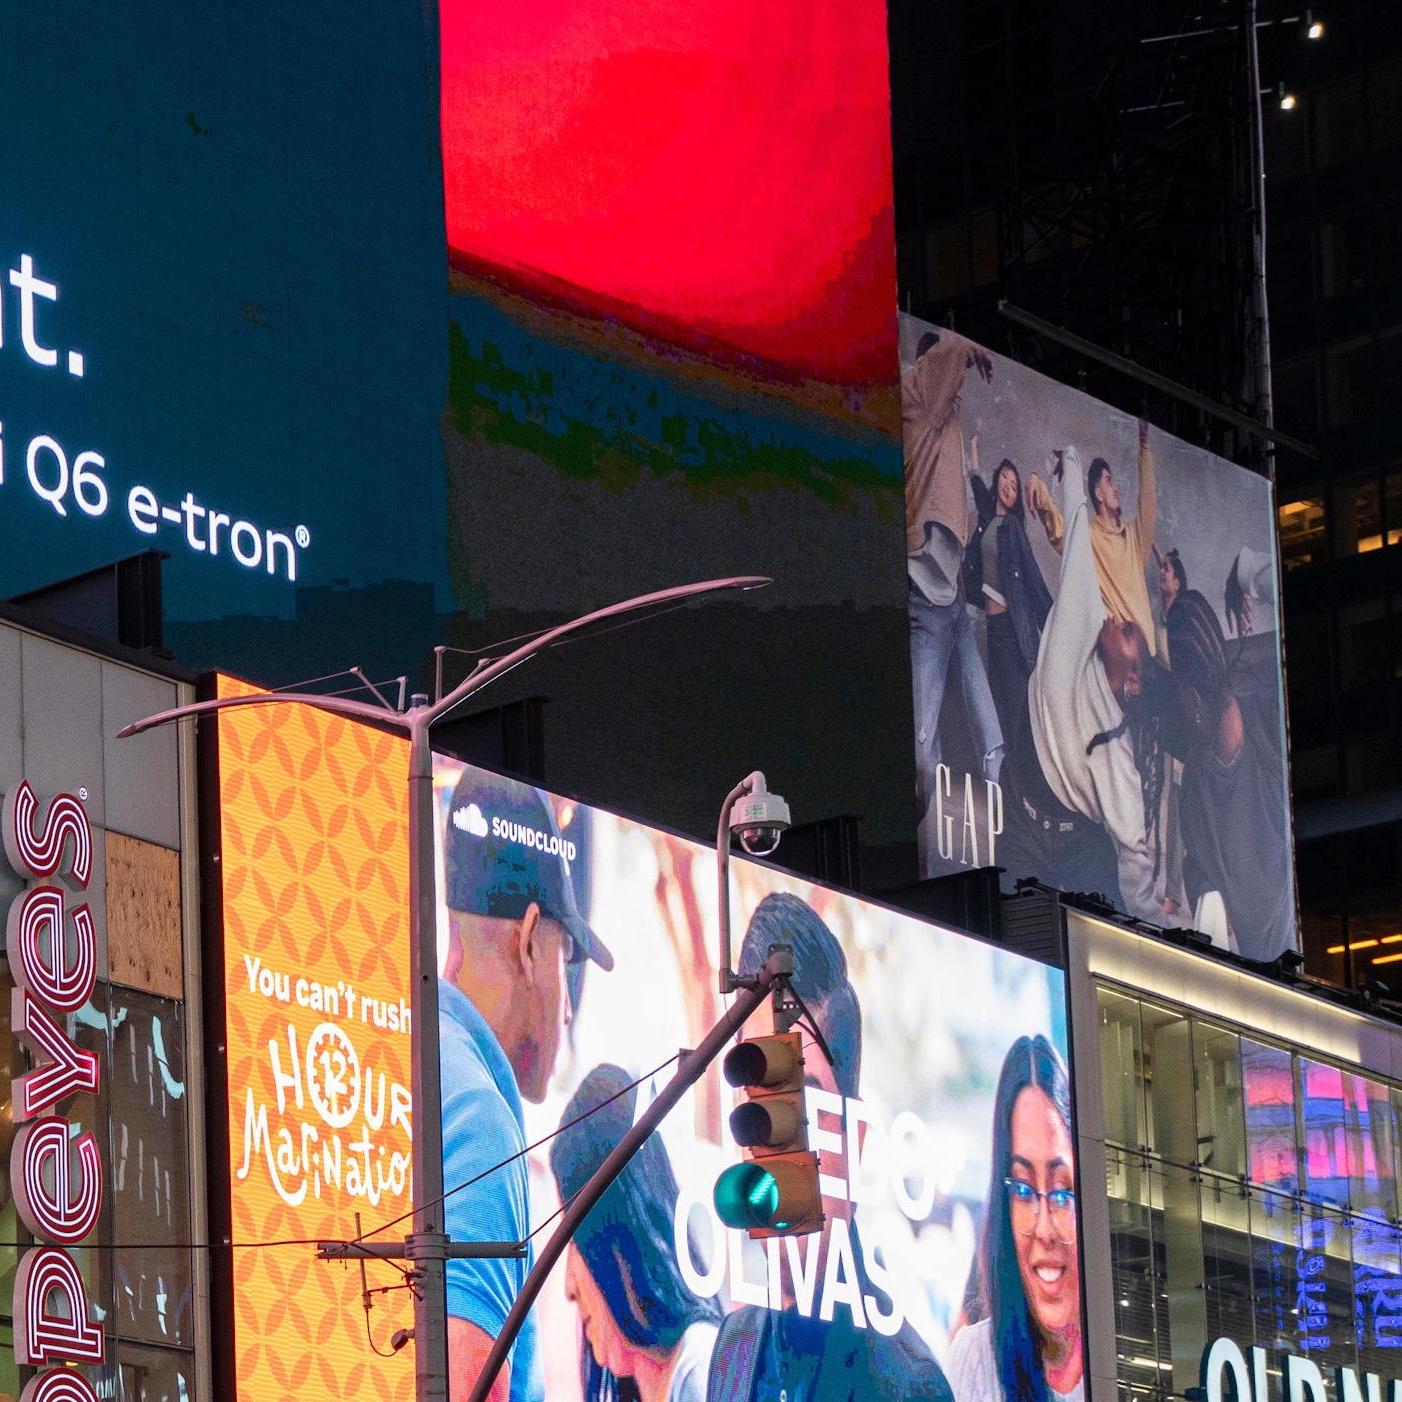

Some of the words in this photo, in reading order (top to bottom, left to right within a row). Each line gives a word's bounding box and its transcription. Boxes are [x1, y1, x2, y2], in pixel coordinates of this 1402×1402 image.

[25, 433, 109, 517] Q6
[492, 816, 577, 861] SOUNDCLOUD
[934, 764, 1005, 869] GAP
[243, 954, 290, 1002] You
[296, 976, 356, 1019] can't
[361, 993, 412, 1035] rush
[674, 1187, 912, 1336] OLIVAS
